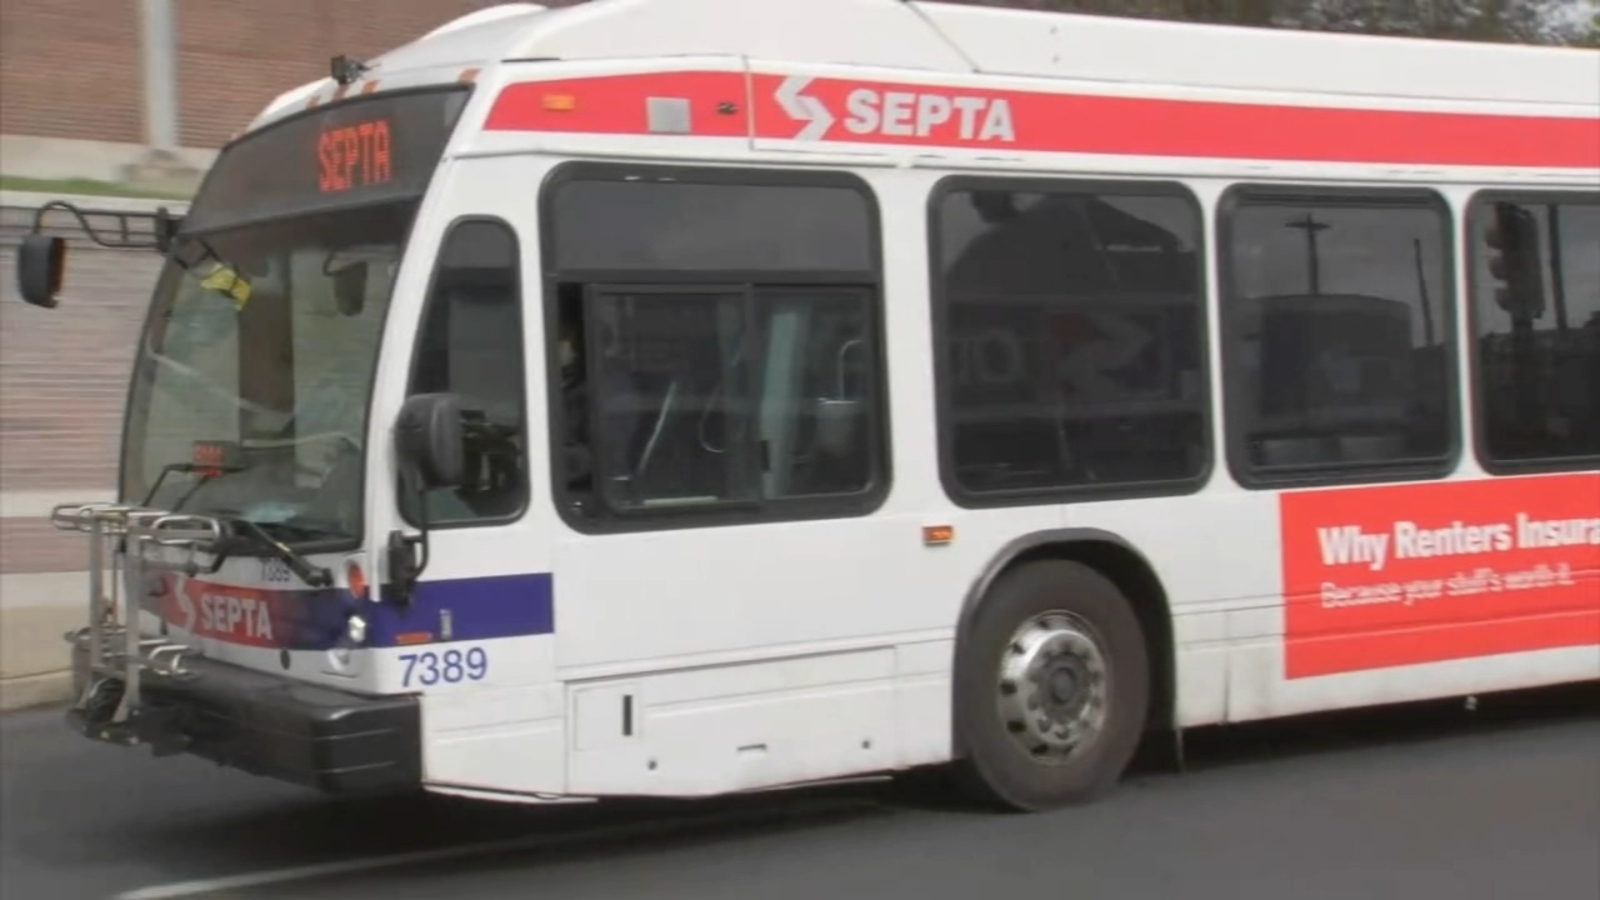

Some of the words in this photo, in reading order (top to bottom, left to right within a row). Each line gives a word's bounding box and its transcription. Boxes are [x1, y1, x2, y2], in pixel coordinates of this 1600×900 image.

[844, 88, 1015, 142] SEPTA
[318, 120, 391, 192] SEPTA
[1317, 525, 1389, 571] Why
[1394, 520, 1512, 558] Renters
[200, 593, 273, 641] SEPTA
[1321, 582, 1401, 608] Because
[1402, 579, 1443, 606] your
[397, 646, 488, 689] 7389
